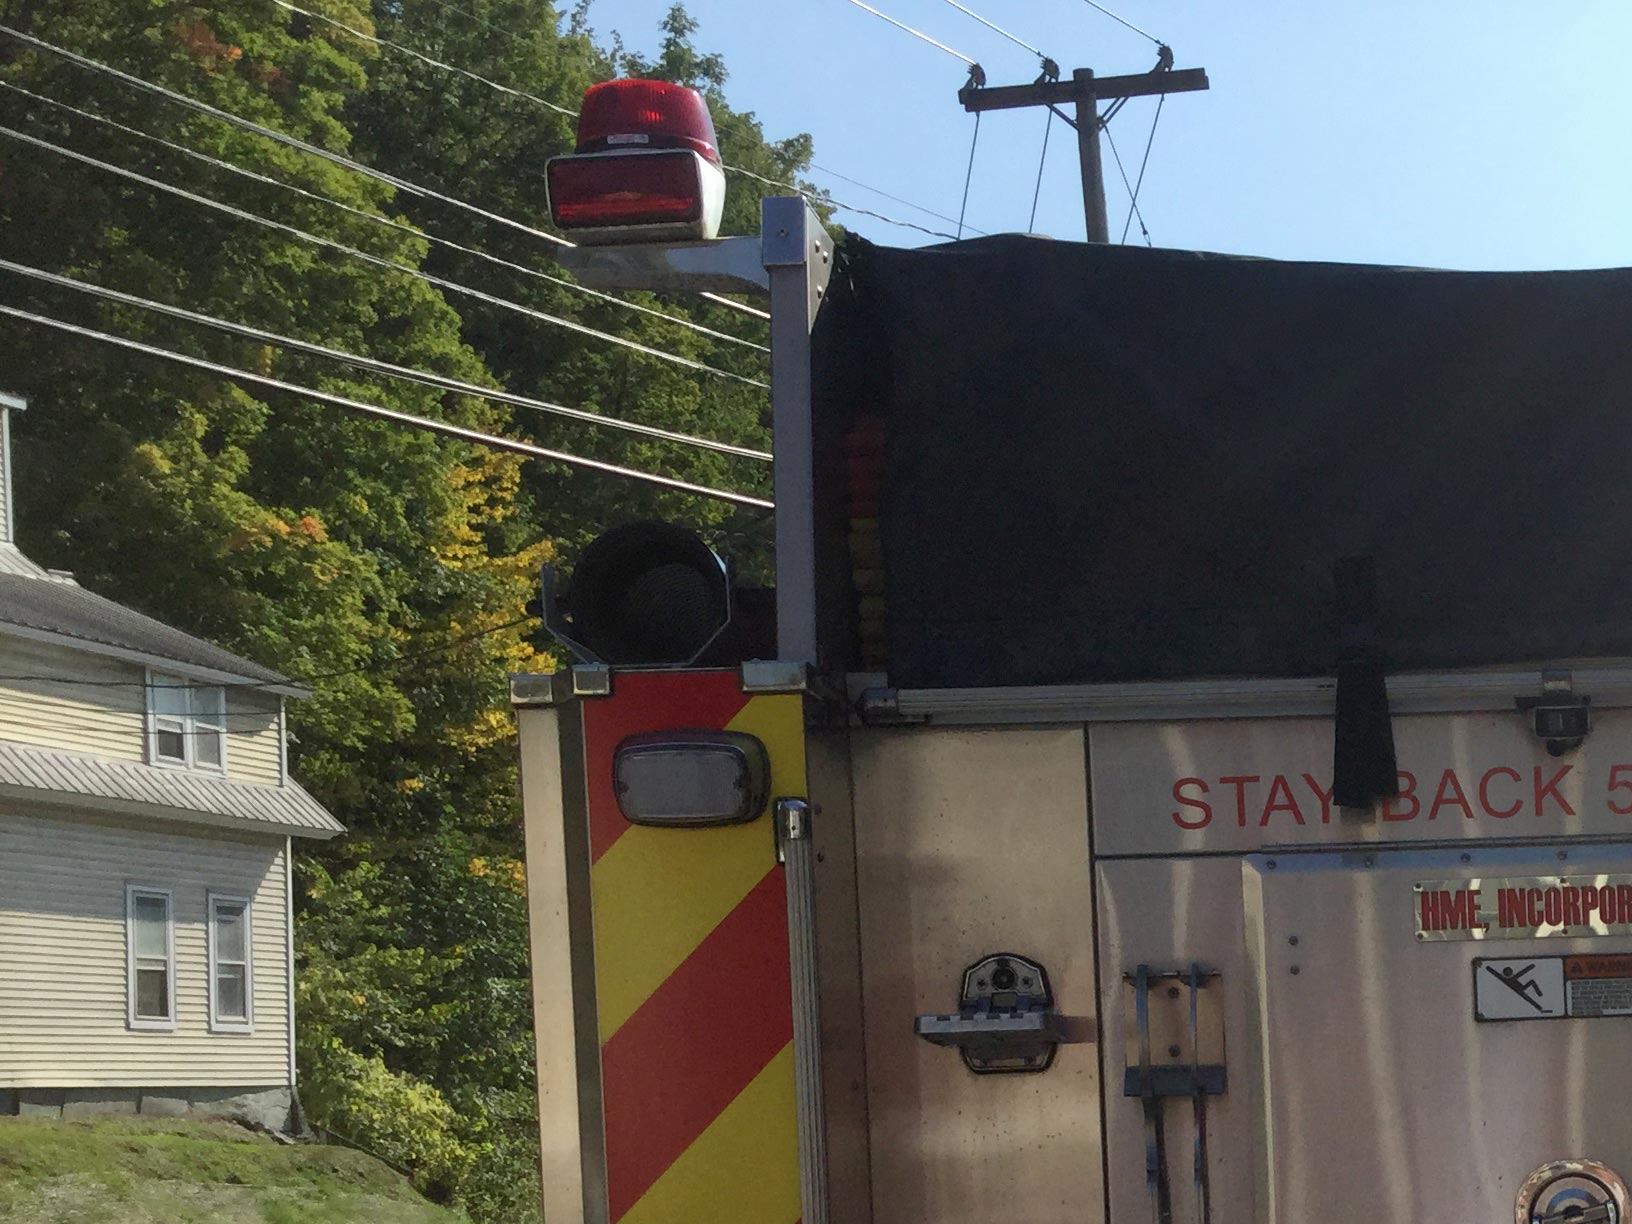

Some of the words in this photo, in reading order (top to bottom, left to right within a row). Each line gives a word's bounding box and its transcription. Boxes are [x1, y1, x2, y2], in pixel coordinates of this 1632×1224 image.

[1171, 772, 1335, 831] STAY
[1381, 764, 1577, 823] BACK
[1420, 888, 1490, 934] HME,
